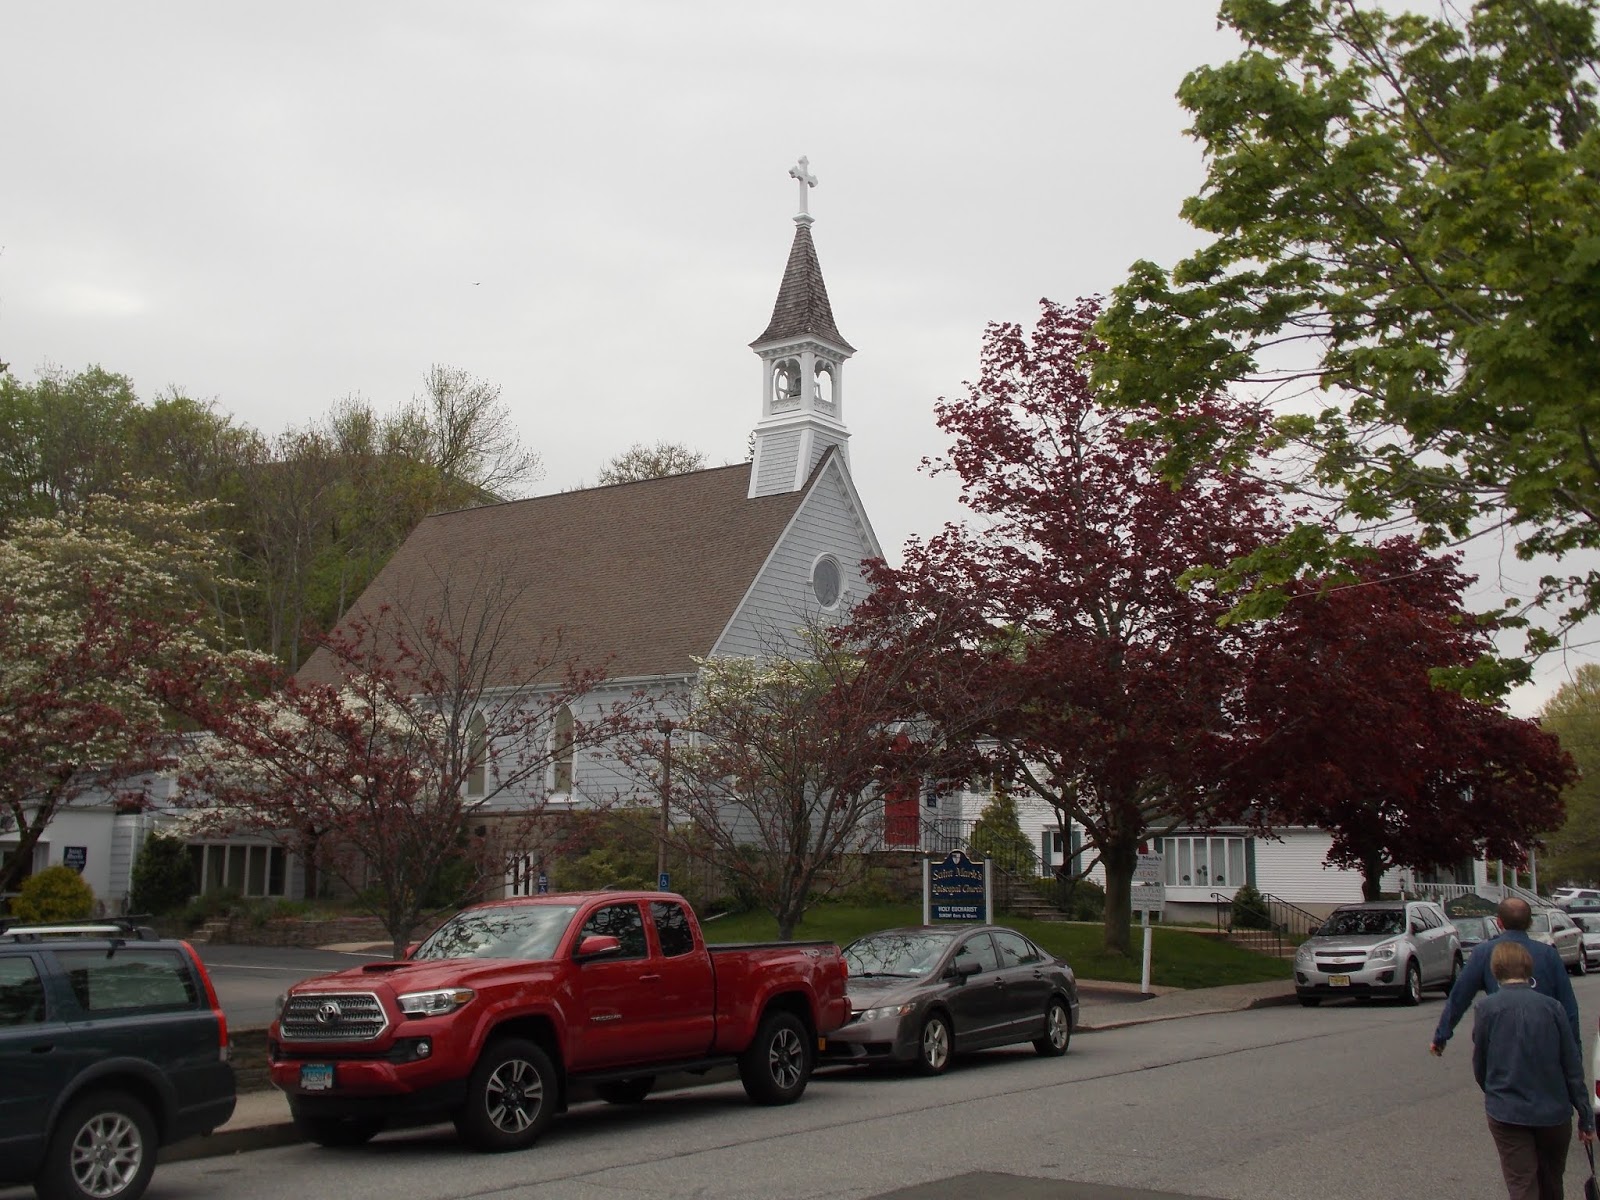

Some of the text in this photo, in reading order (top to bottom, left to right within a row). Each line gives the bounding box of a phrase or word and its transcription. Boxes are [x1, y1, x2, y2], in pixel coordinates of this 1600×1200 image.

[932, 867, 983, 881] Saint Mark's
[932, 884, 983, 896] Episcopal Church
